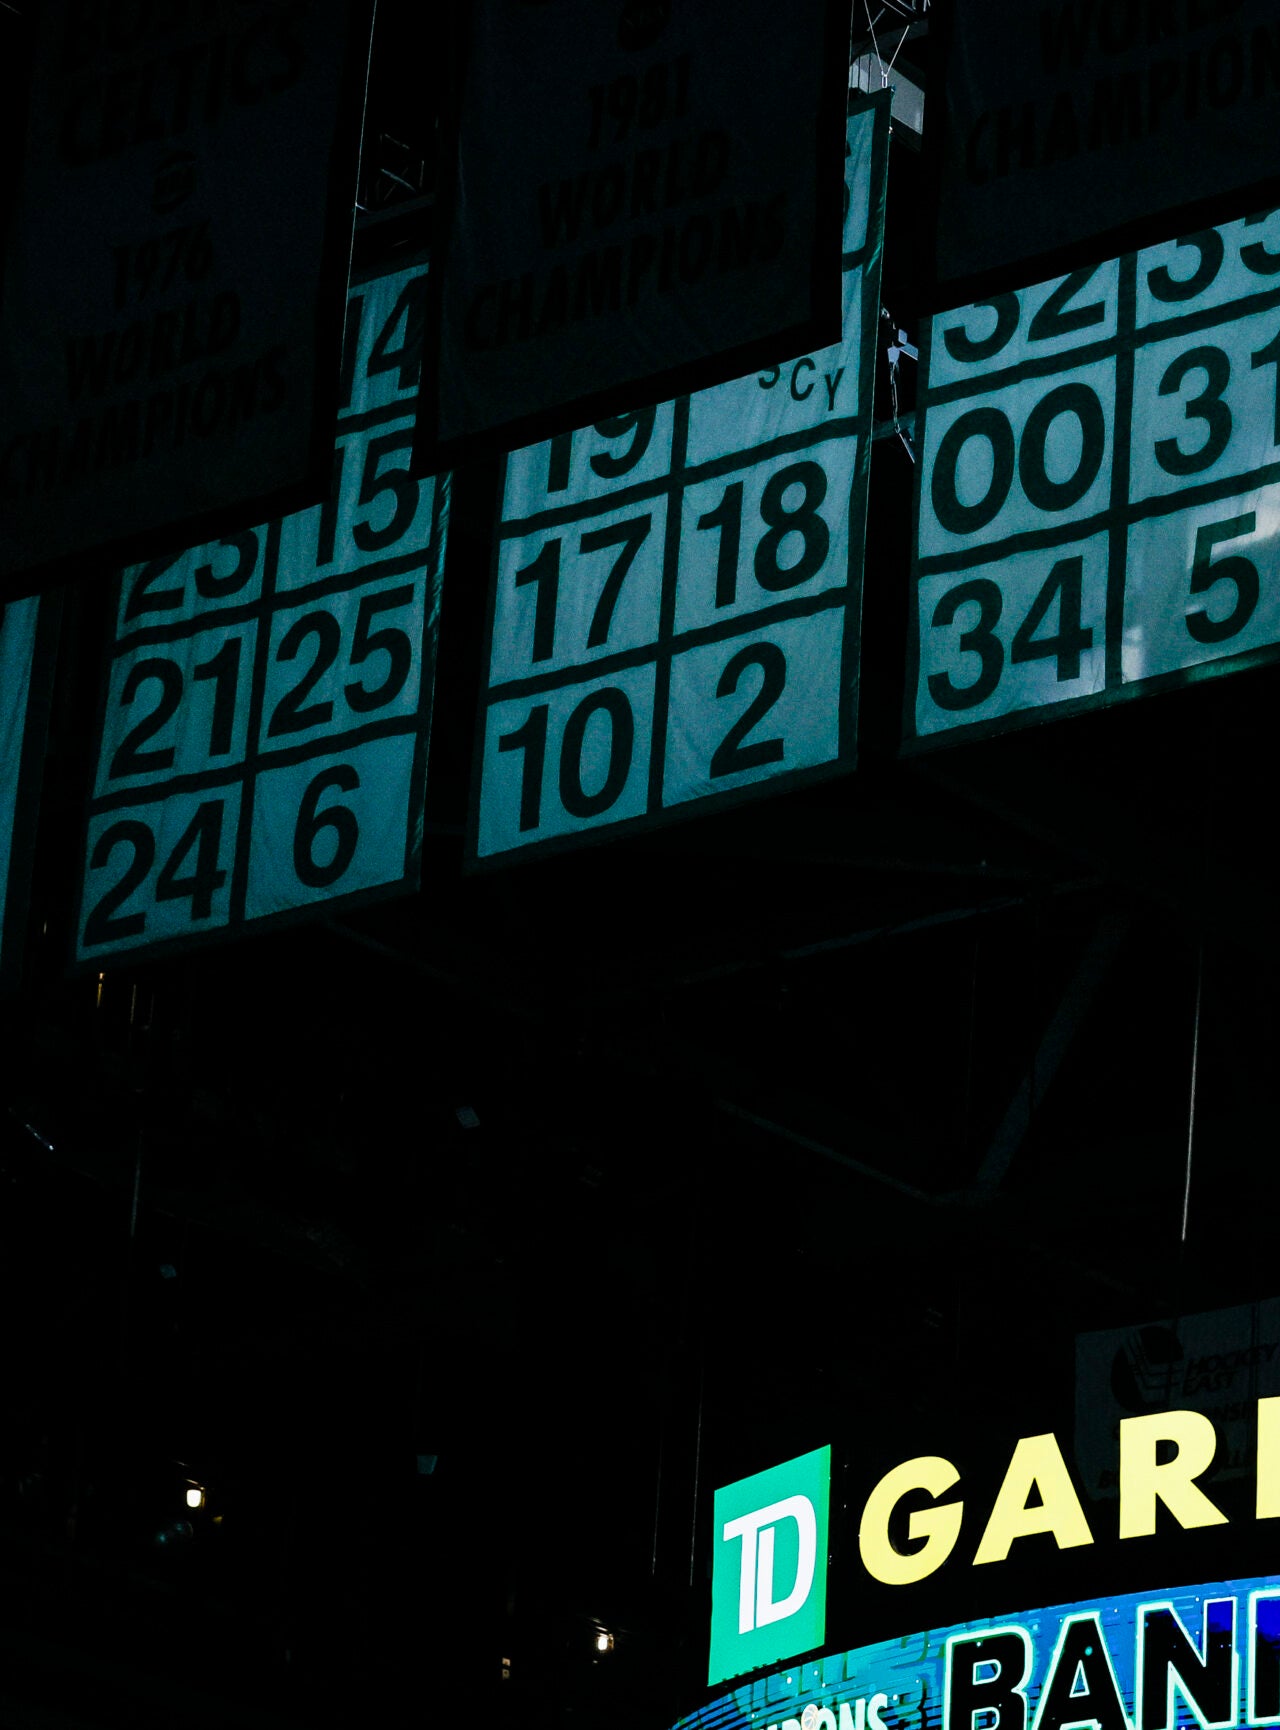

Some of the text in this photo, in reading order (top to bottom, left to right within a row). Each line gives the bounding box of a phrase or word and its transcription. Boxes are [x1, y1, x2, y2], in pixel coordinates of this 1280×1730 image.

[587, 53, 691, 148] 1981
[538, 129, 731, 249] WORLD
[464, 188, 788, 351] CHAMPIONS
[66, 290, 241, 400] WORLD
[2, 344, 287, 494] CHAMPIONS
[931, 382, 1105, 534] 00
[317, 428, 421, 566] 15
[697, 460, 830, 609] 18
[515, 512, 652, 665] 17
[927, 555, 1093, 711] 34
[1185, 512, 1259, 644] 5
[109, 638, 242, 779] 21
[267, 584, 415, 738] 25
[710, 642, 787, 779] 2
[294, 764, 360, 888] 6
[499, 687, 634, 833] 10
[82, 800, 226, 947] 24
[1186, 1342, 1279, 1374] HOCKEY
[723, 1494, 817, 1635] TD
